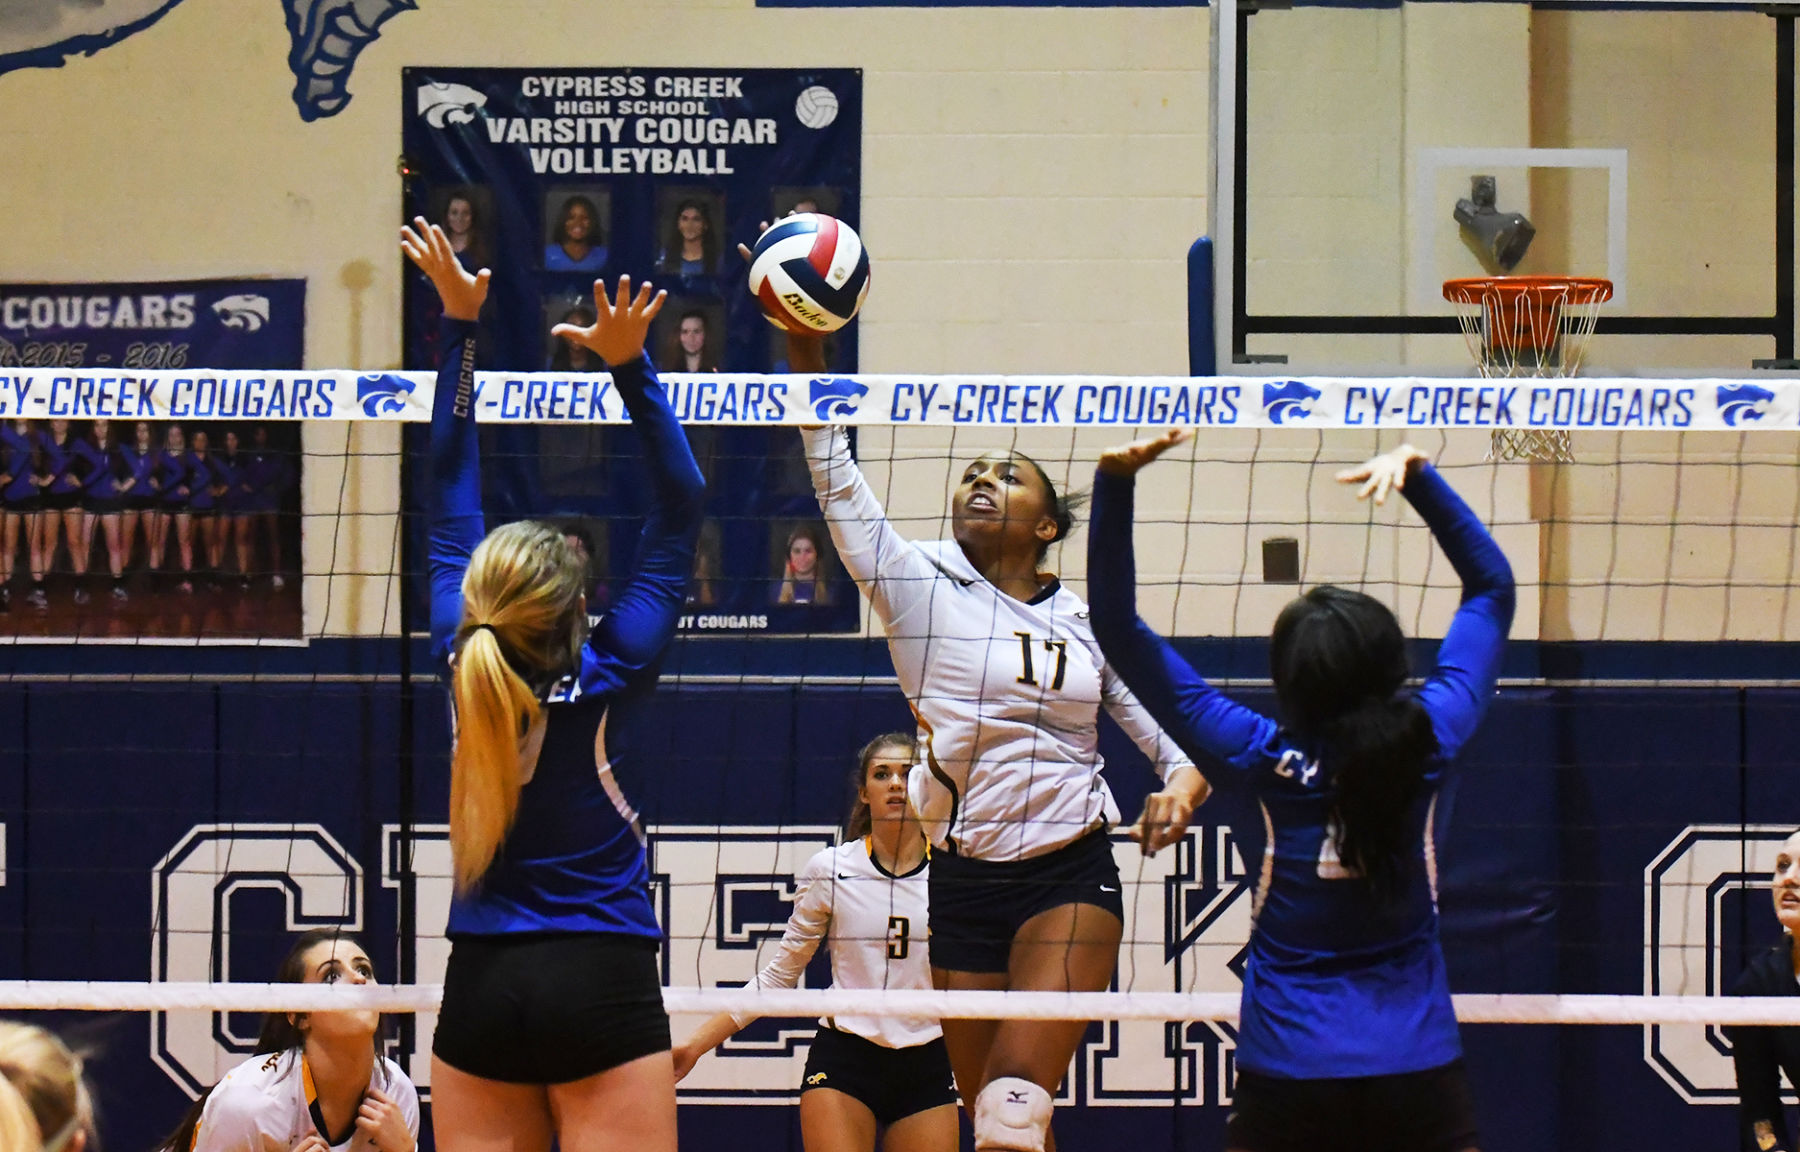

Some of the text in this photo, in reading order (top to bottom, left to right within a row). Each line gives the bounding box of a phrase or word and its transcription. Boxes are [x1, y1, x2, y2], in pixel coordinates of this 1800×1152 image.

[522, 76, 743, 98] CYPRESS CREEK
[554, 101, 710, 115] HIGH SCHOOL
[486, 118, 777, 144] VARSITY COUGAR
[529, 148, 734, 174] VOLLEYBALL
[3, 294, 196, 330] COUGARS
[21, 342, 87, 368] 2015
[122, 342, 190, 369] 2016
[453, 338, 476, 418] COUGARS
[170, 379, 335, 417] COUGARS
[622, 382, 787, 421] UGARS
[890, 383, 1240, 424] CY-CREEK COUGARS
[1344, 386, 1694, 427] CY-CREEK COUGARS
[698, 615, 768, 628] COUGARS
[1013, 631, 1067, 690] 17
[888, 915, 910, 959] 3
